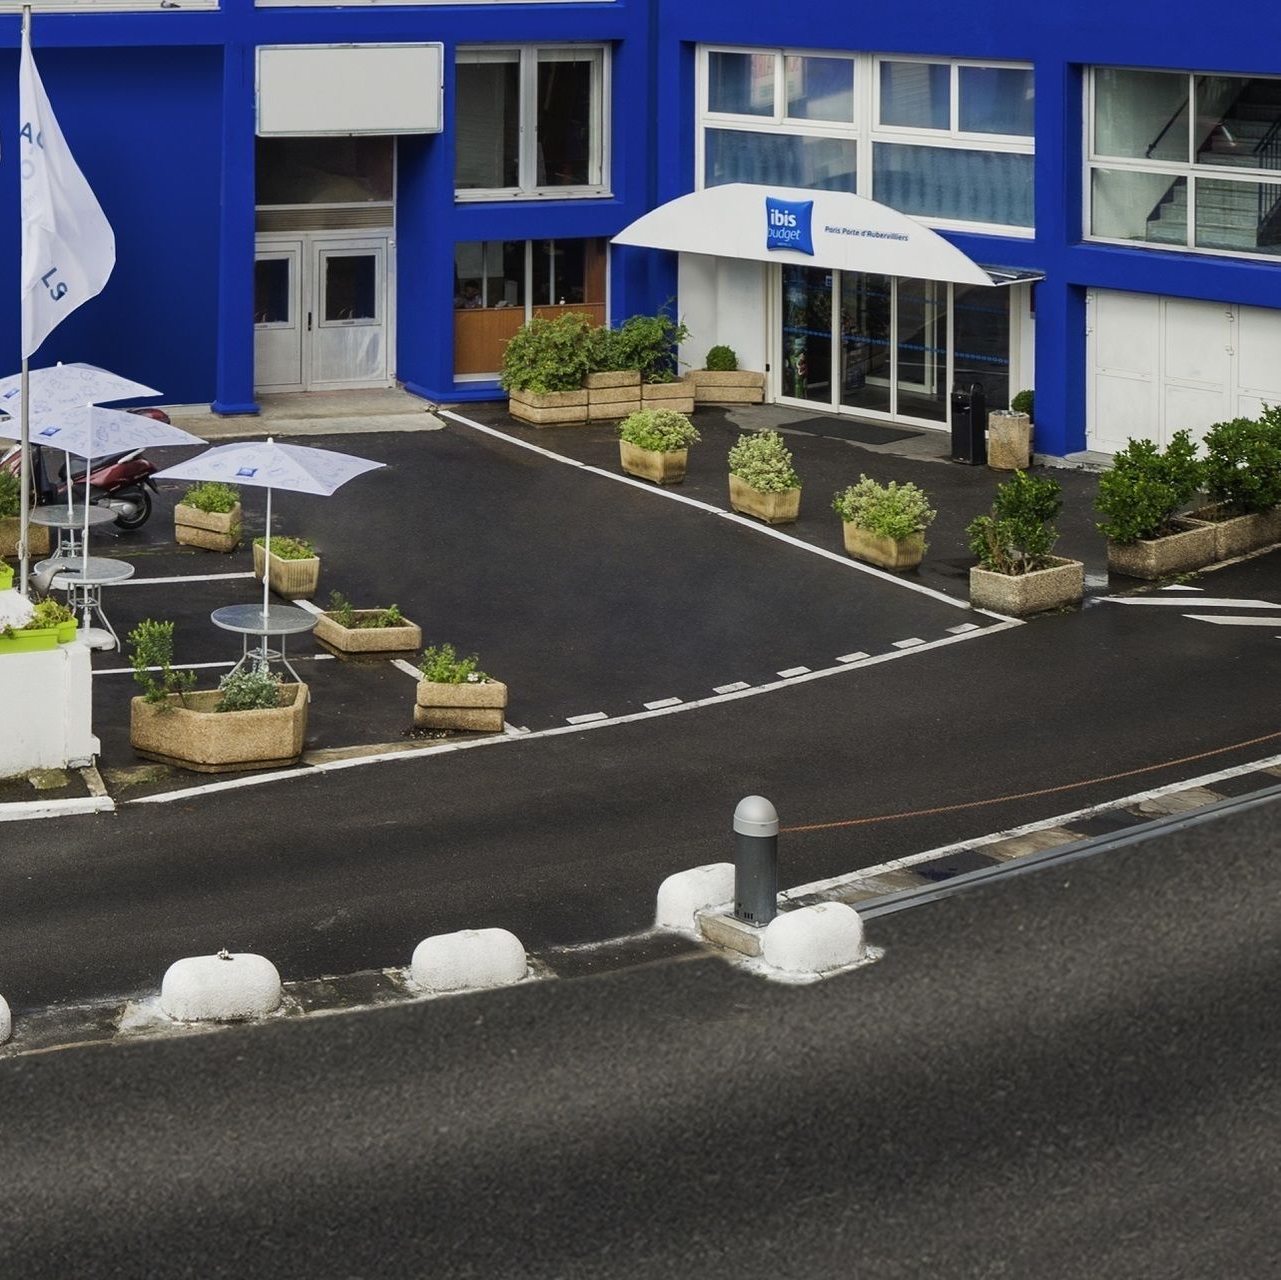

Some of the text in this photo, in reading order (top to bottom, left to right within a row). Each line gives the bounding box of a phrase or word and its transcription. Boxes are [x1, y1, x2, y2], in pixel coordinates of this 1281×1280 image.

[770, 208, 797, 227] ibis
[824, 225, 841, 234] Paris
[842, 227, 859, 237] Porte
